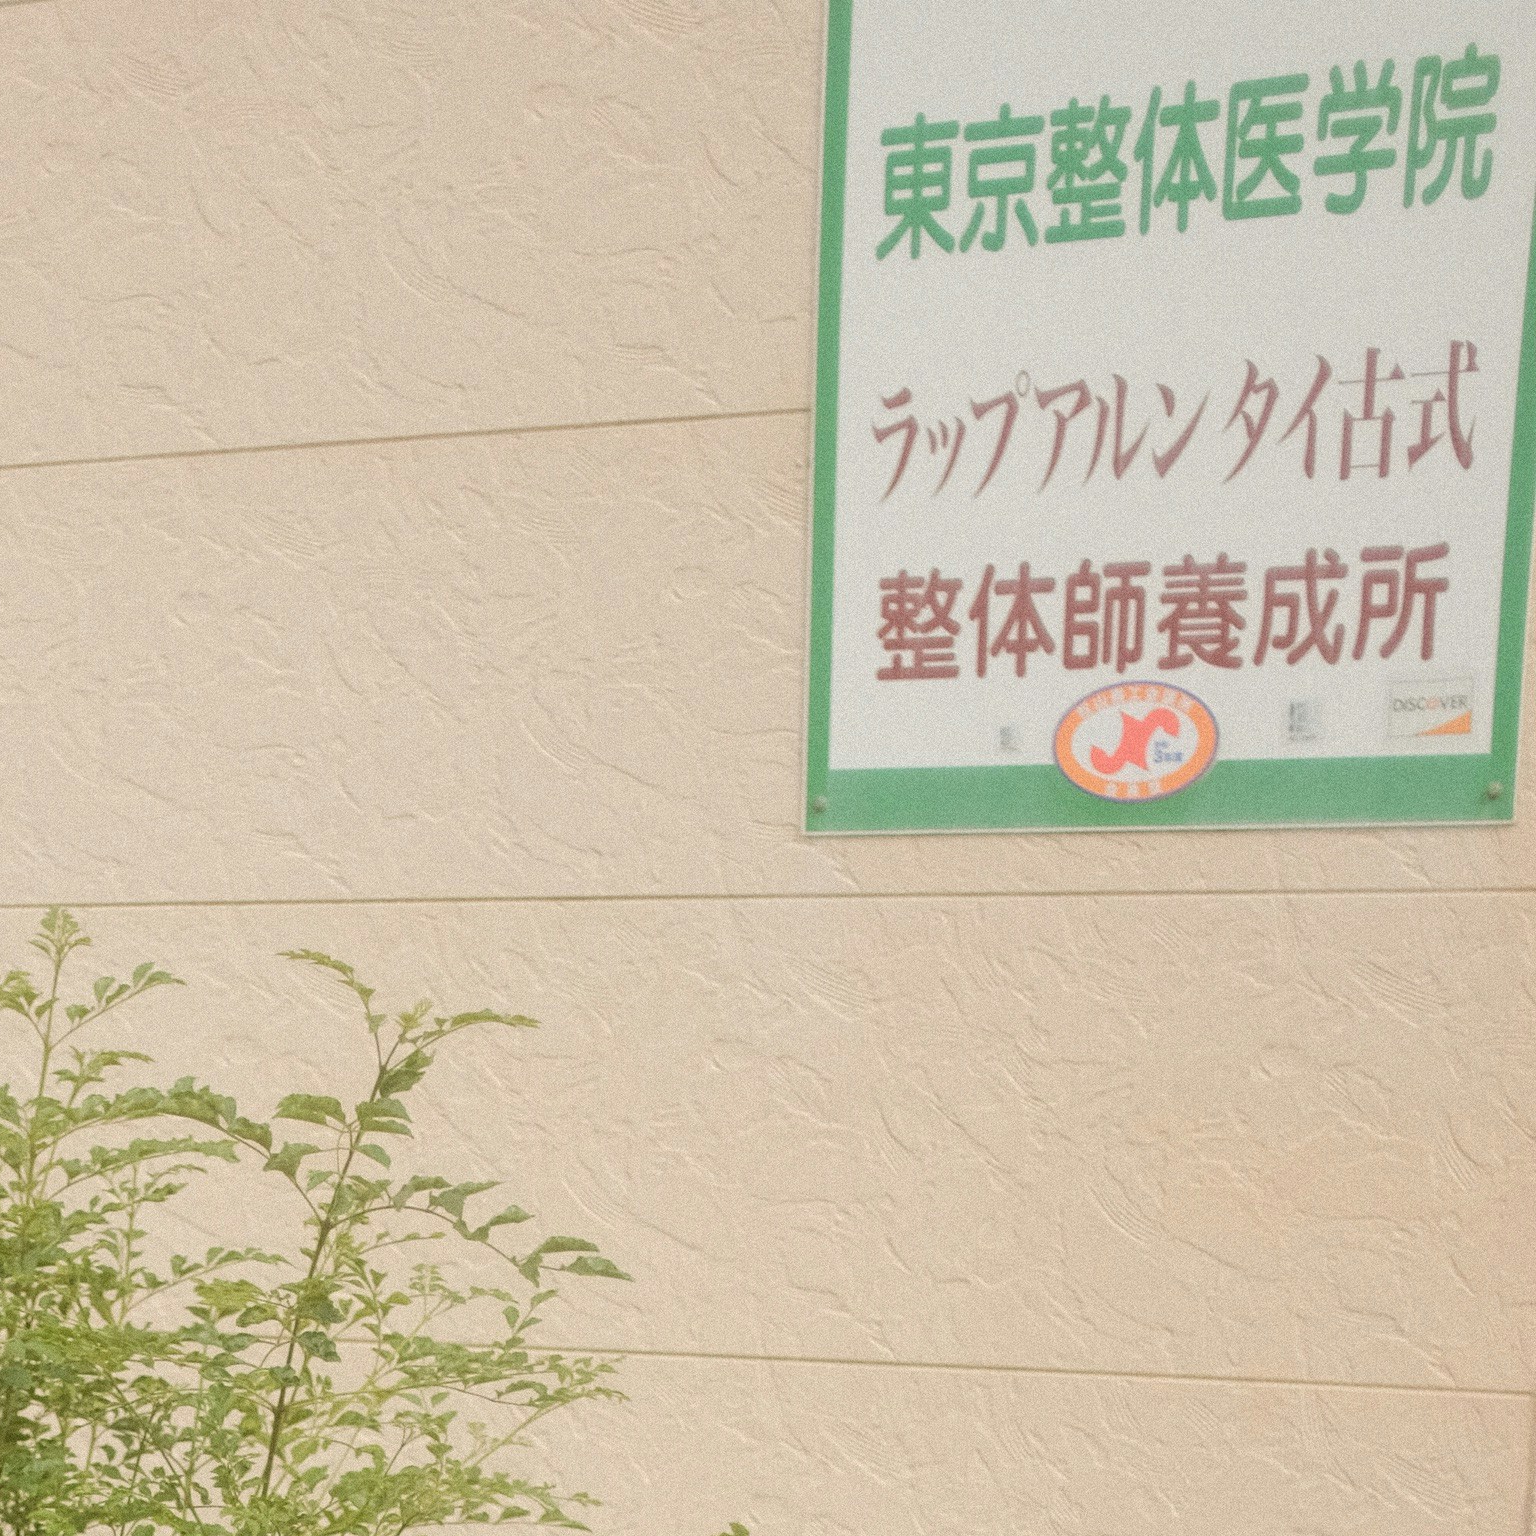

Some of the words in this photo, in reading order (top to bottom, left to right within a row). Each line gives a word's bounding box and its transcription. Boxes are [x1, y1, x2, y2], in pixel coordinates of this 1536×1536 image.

[875, 43, 1502, 260] 東京整体医学院
[875, 543, 1450, 682] 整体師養成所
